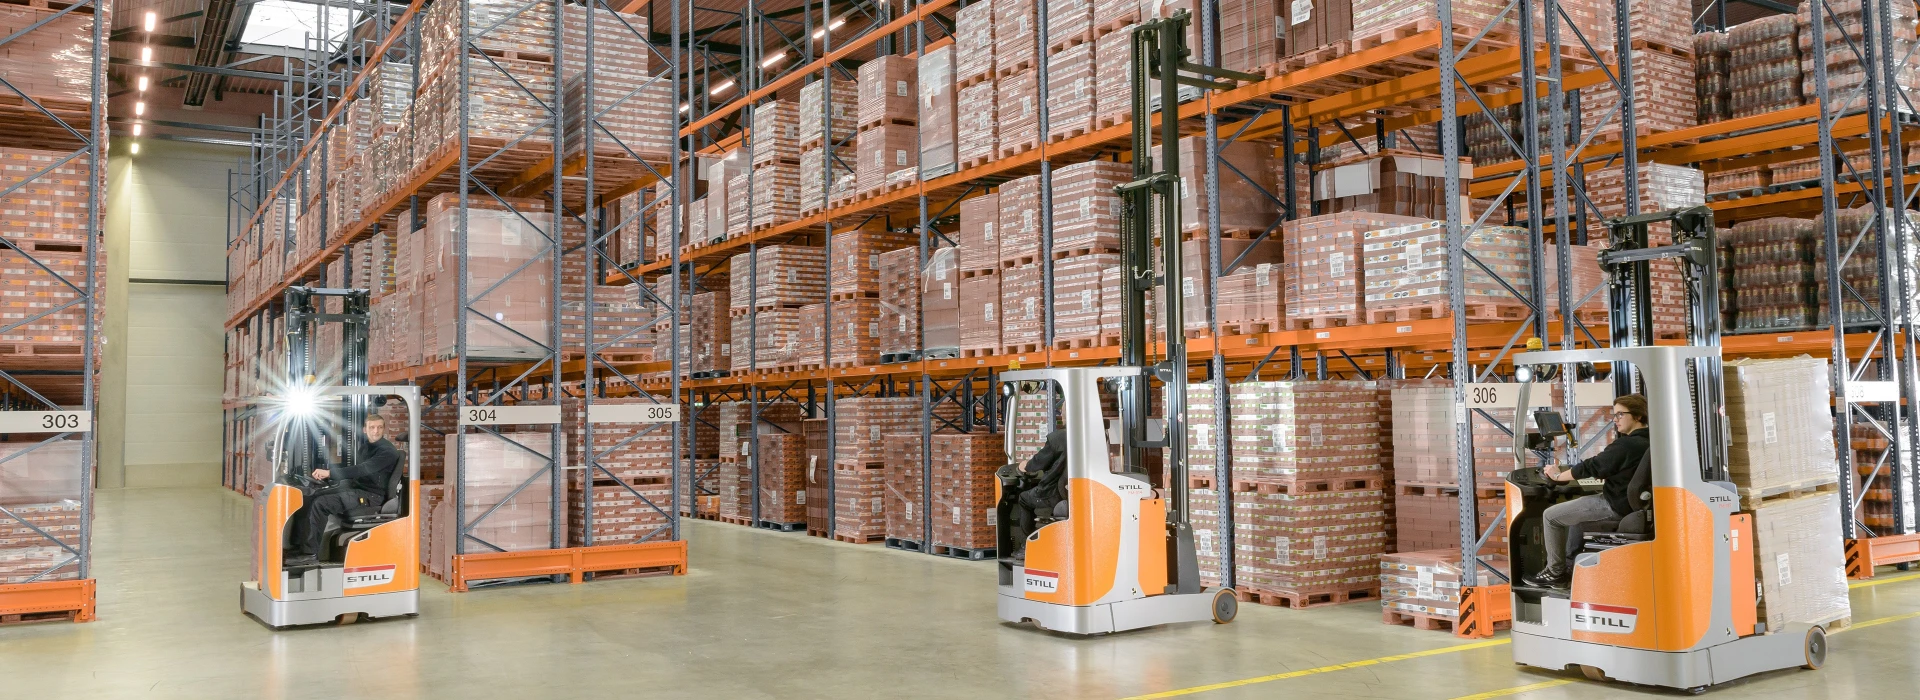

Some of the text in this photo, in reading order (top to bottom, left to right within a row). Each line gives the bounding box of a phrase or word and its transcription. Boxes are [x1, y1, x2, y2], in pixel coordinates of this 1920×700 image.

[1473, 387, 1497, 404] 306
[469, 409, 497, 422] 304
[647, 407, 672, 419] 305
[42, 414, 79, 429] 303
[1709, 495, 1732, 503] STILL
[347, 573, 390, 583] STILL
[1026, 578, 1055, 589] STILL
[1575, 613, 1630, 629] STILL
